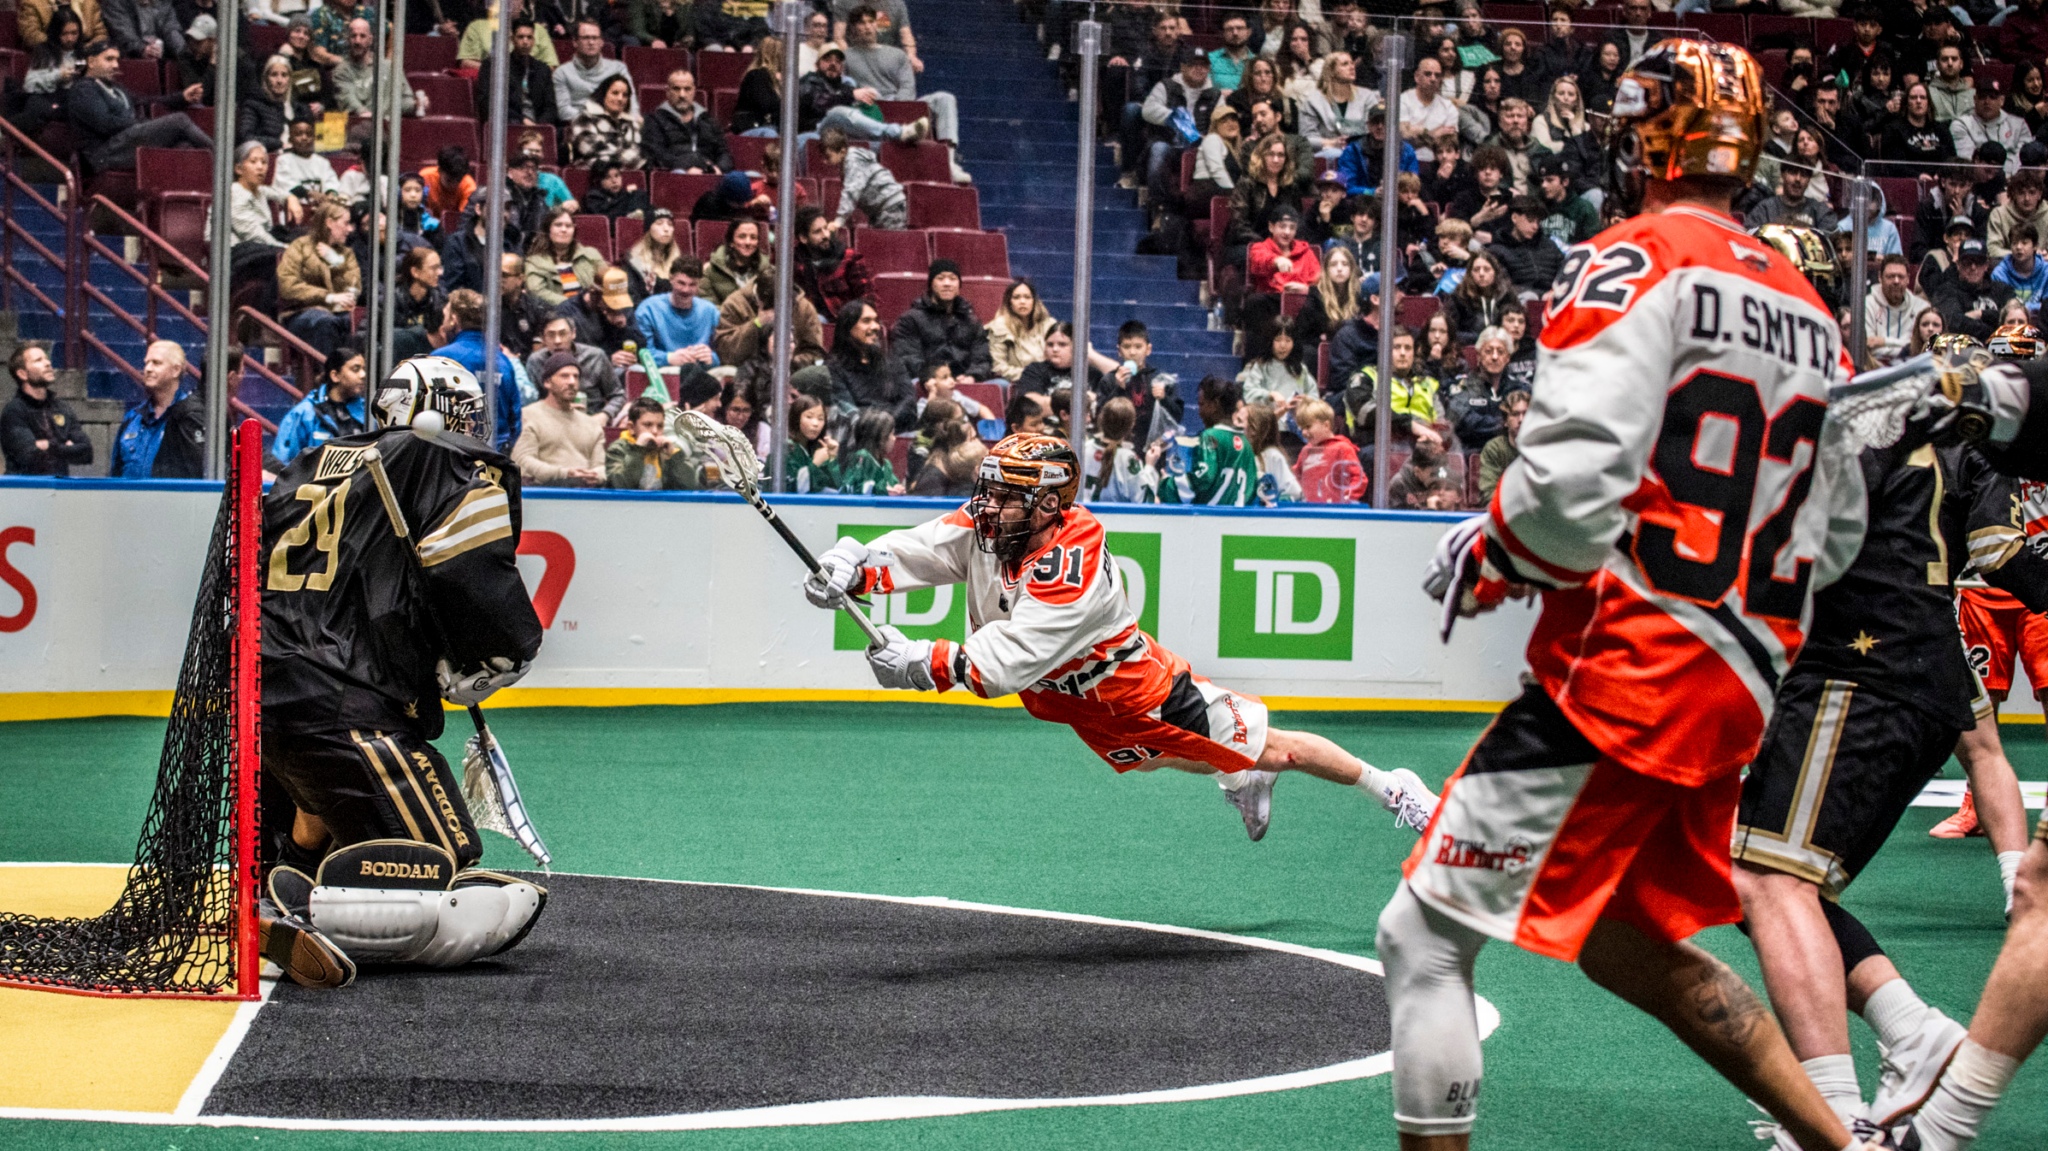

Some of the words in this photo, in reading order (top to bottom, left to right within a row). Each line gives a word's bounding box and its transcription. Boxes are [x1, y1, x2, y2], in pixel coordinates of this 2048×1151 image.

[1547, 242, 1653, 319] 92
[1690, 283, 1733, 343] D.
[1631, 368, 1828, 622] 92
[267, 478, 352, 592] 29
[1031, 544, 1085, 588] 91
[1232, 558, 1341, 635] TD
[411, 751, 470, 849] BODDAM
[360, 860, 440, 880] BODDAM
